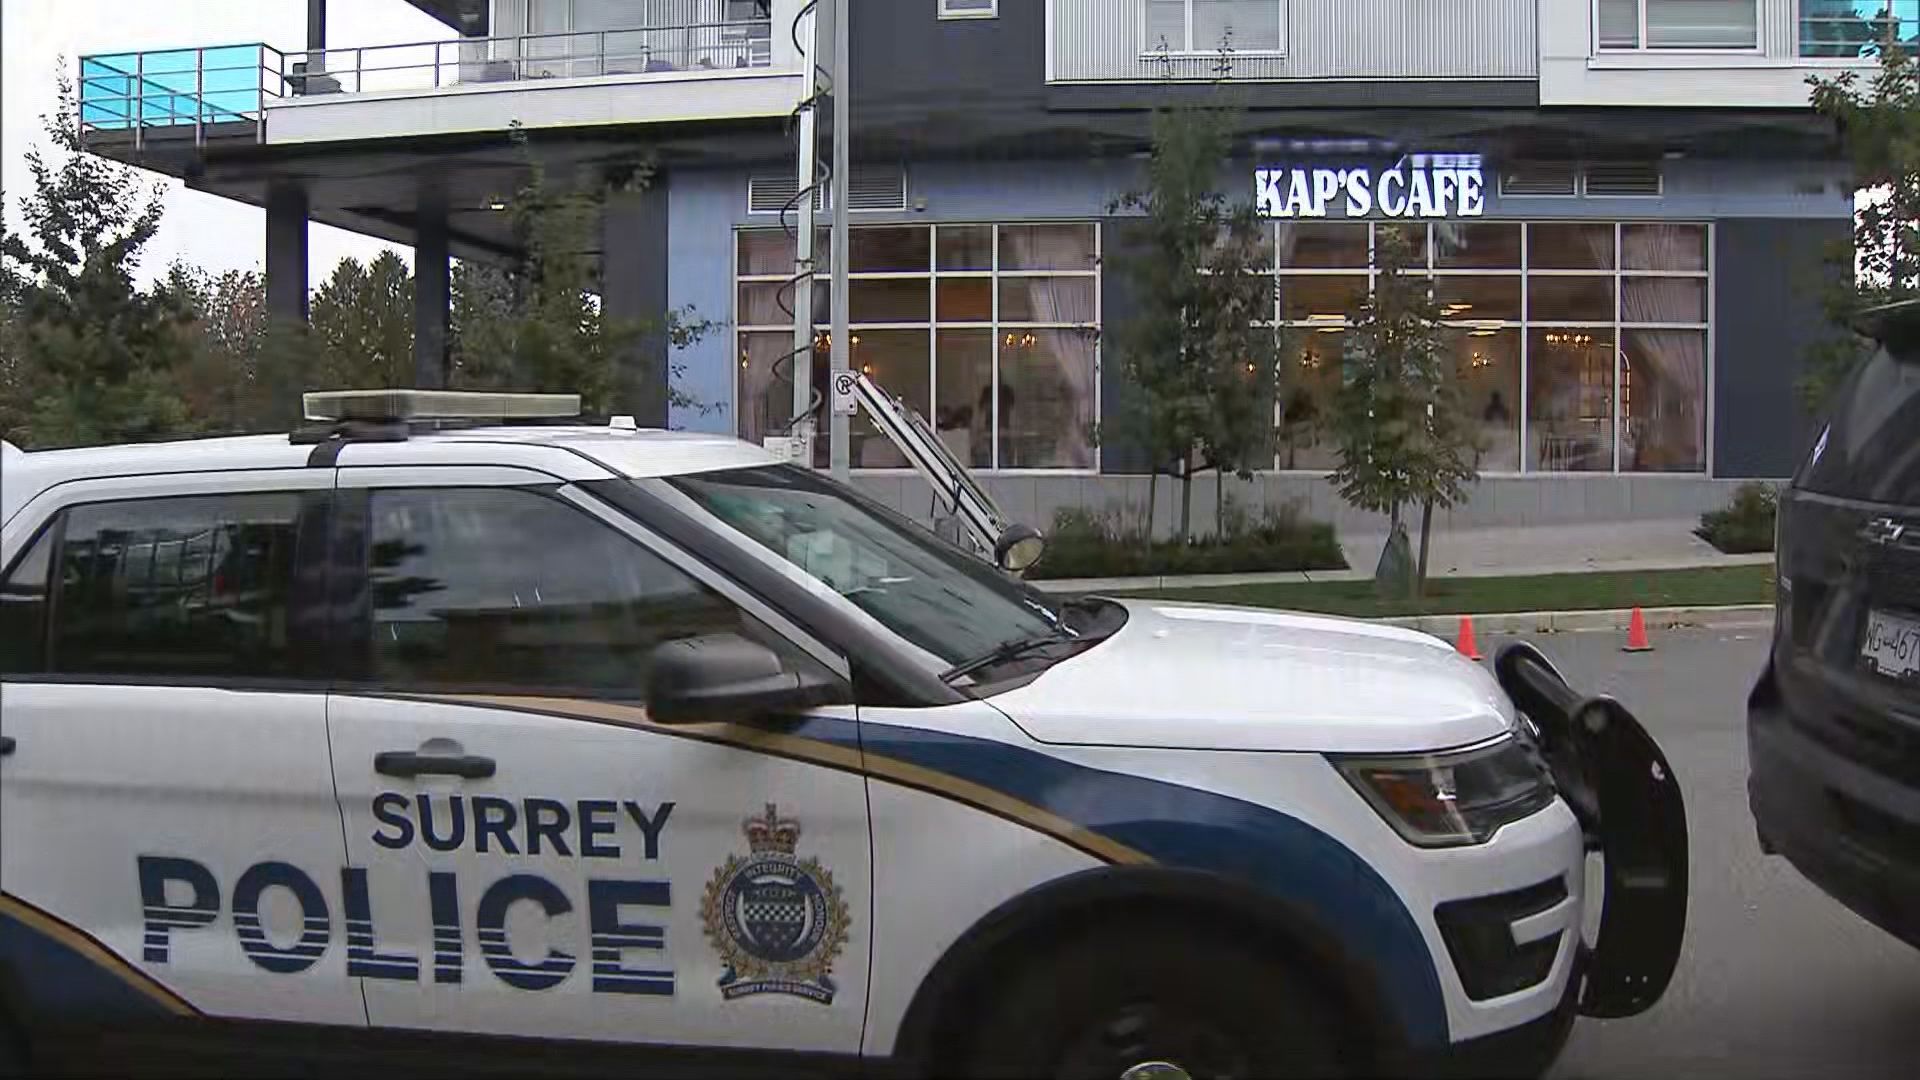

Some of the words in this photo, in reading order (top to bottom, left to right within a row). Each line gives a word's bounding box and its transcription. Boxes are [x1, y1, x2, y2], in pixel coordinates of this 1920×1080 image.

[1255, 168, 1372, 217] KAP'S
[371, 792, 677, 860] SURREY
[137, 855, 676, 995] POLICE
